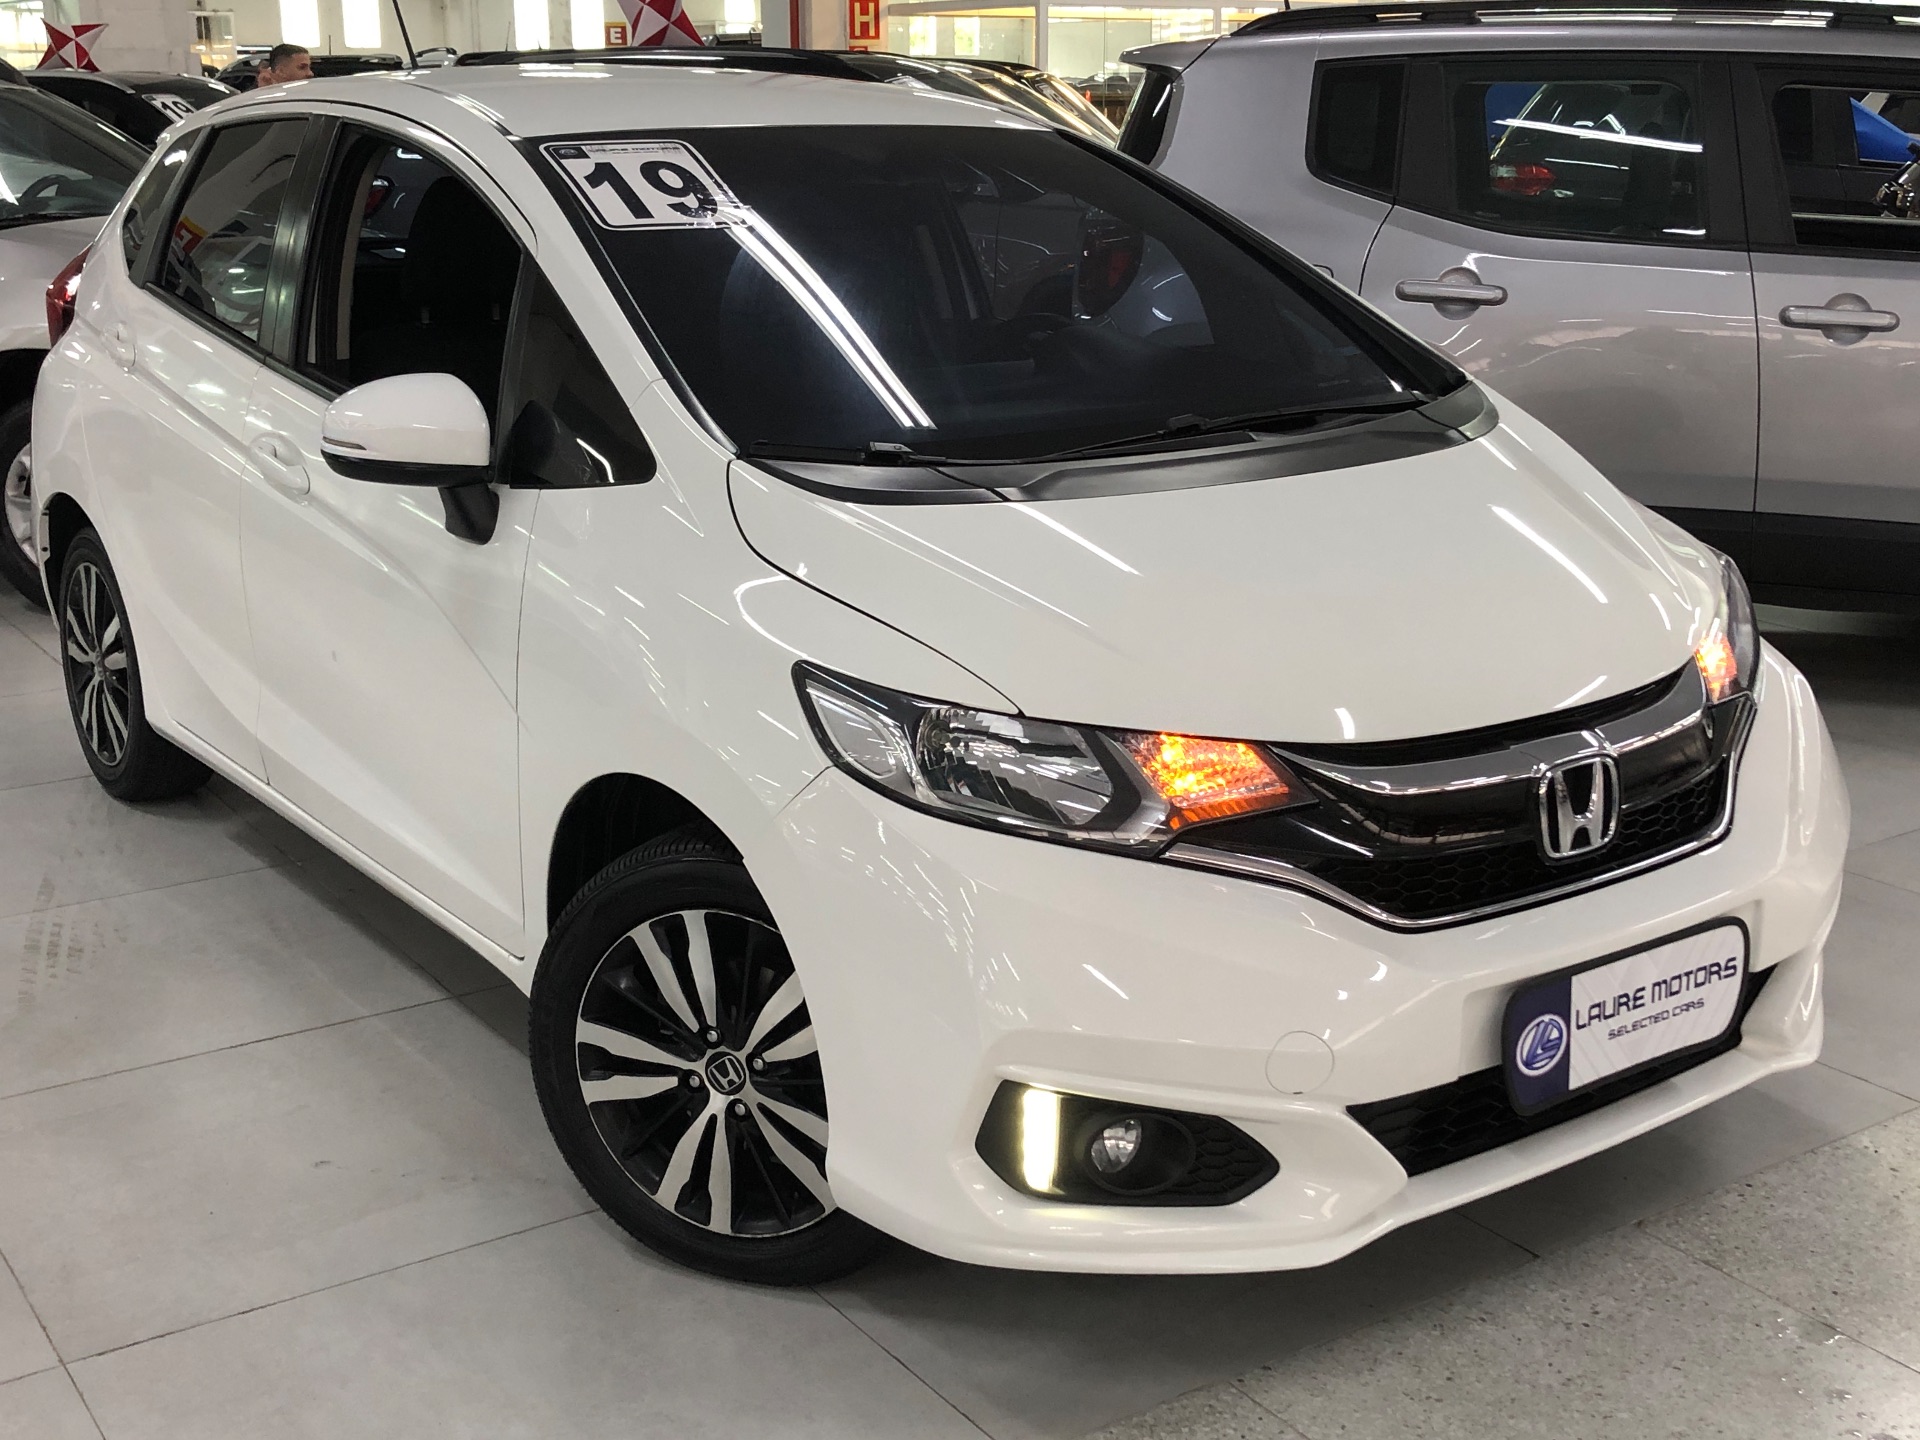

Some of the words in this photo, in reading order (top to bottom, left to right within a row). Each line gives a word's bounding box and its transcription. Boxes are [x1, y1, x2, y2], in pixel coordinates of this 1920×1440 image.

[609, 27, 622, 43] E
[854, 2, 875, 37] H
[160, 101, 194, 119] 19
[583, 160, 718, 219] 19
[1575, 986, 1646, 1030] LAURE
[1651, 956, 1737, 1003] MOTORS
[1607, 1009, 1670, 1040] SELECTED
[1671, 998, 1705, 1017] CARS
